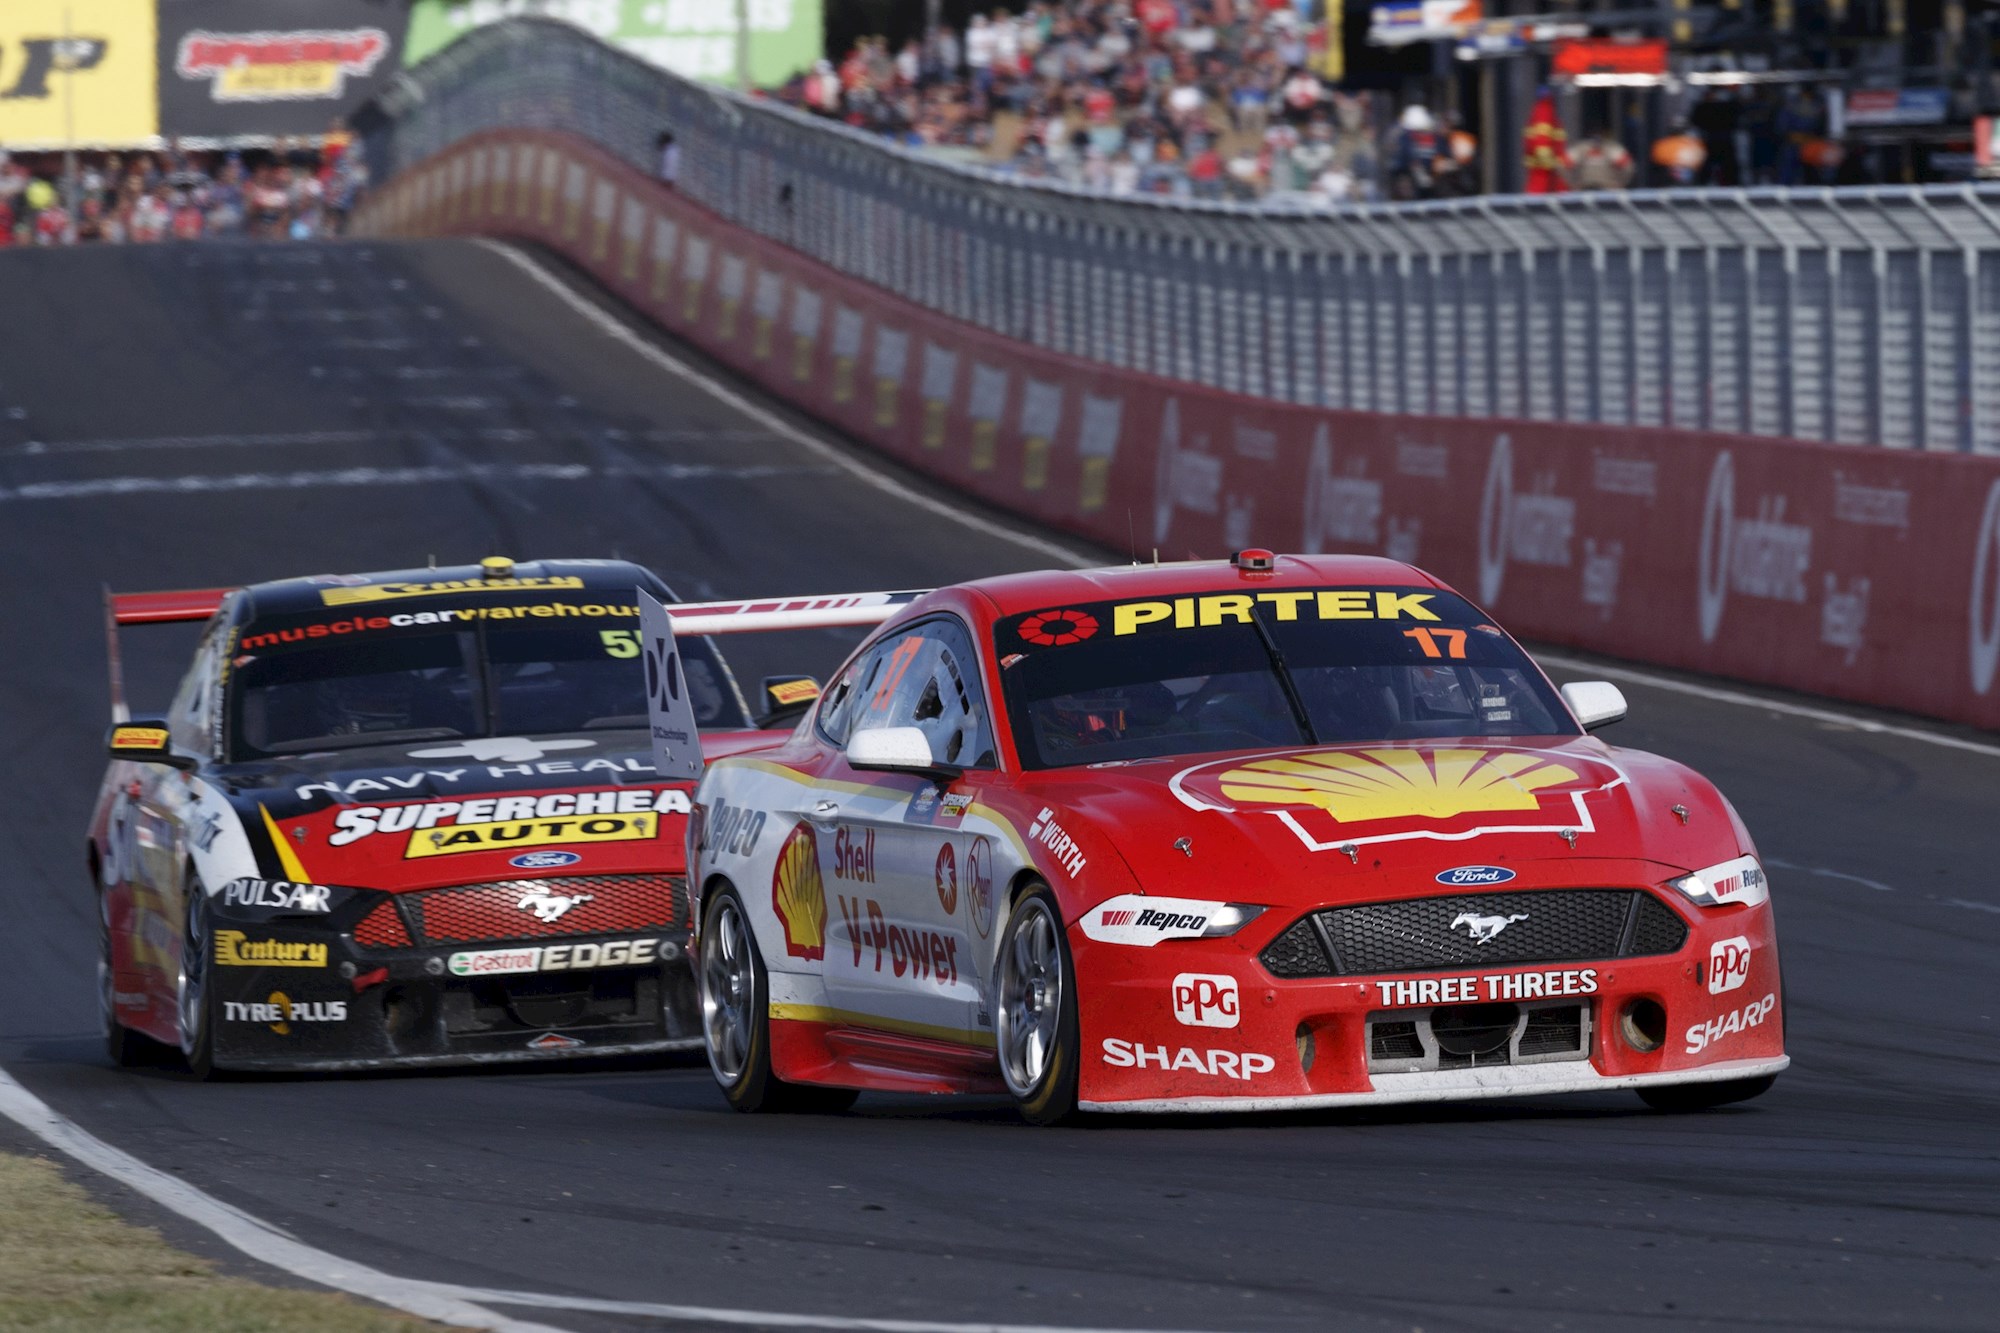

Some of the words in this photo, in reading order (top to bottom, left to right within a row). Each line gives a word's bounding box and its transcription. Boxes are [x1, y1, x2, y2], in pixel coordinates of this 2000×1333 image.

[240, 602, 641, 649] musclecarwarehou
[1114, 591, 1443, 636] PIRTEK
[599, 629, 643, 658] 5
[1402, 626, 1467, 659] 17
[870, 636, 925, 712] 17
[295, 767, 468, 801] NAVY
[486, 757, 657, 778] HEAL
[328, 789, 692, 847] SUPERCHEA
[440, 818, 627, 847] AUTO
[834, 824, 876, 885] Shell
[1451, 867, 1502, 883] Ford
[224, 878, 332, 913] PULSAR
[837, 893, 958, 987] V-Power
[1135, 908, 1207, 931] Repco
[214, 930, 328, 967] Century
[472, 951, 534, 973] Castrol
[541, 937, 661, 971] EDGE
[1711, 944, 1750, 988] PPG
[1175, 978, 1238, 1022] PPG
[1376, 976, 1479, 1007] THREE
[1483, 968, 1599, 1001] THREES
[1684, 992, 1776, 1056] SHARP
[1102, 1037, 1276, 1081] SHARP
